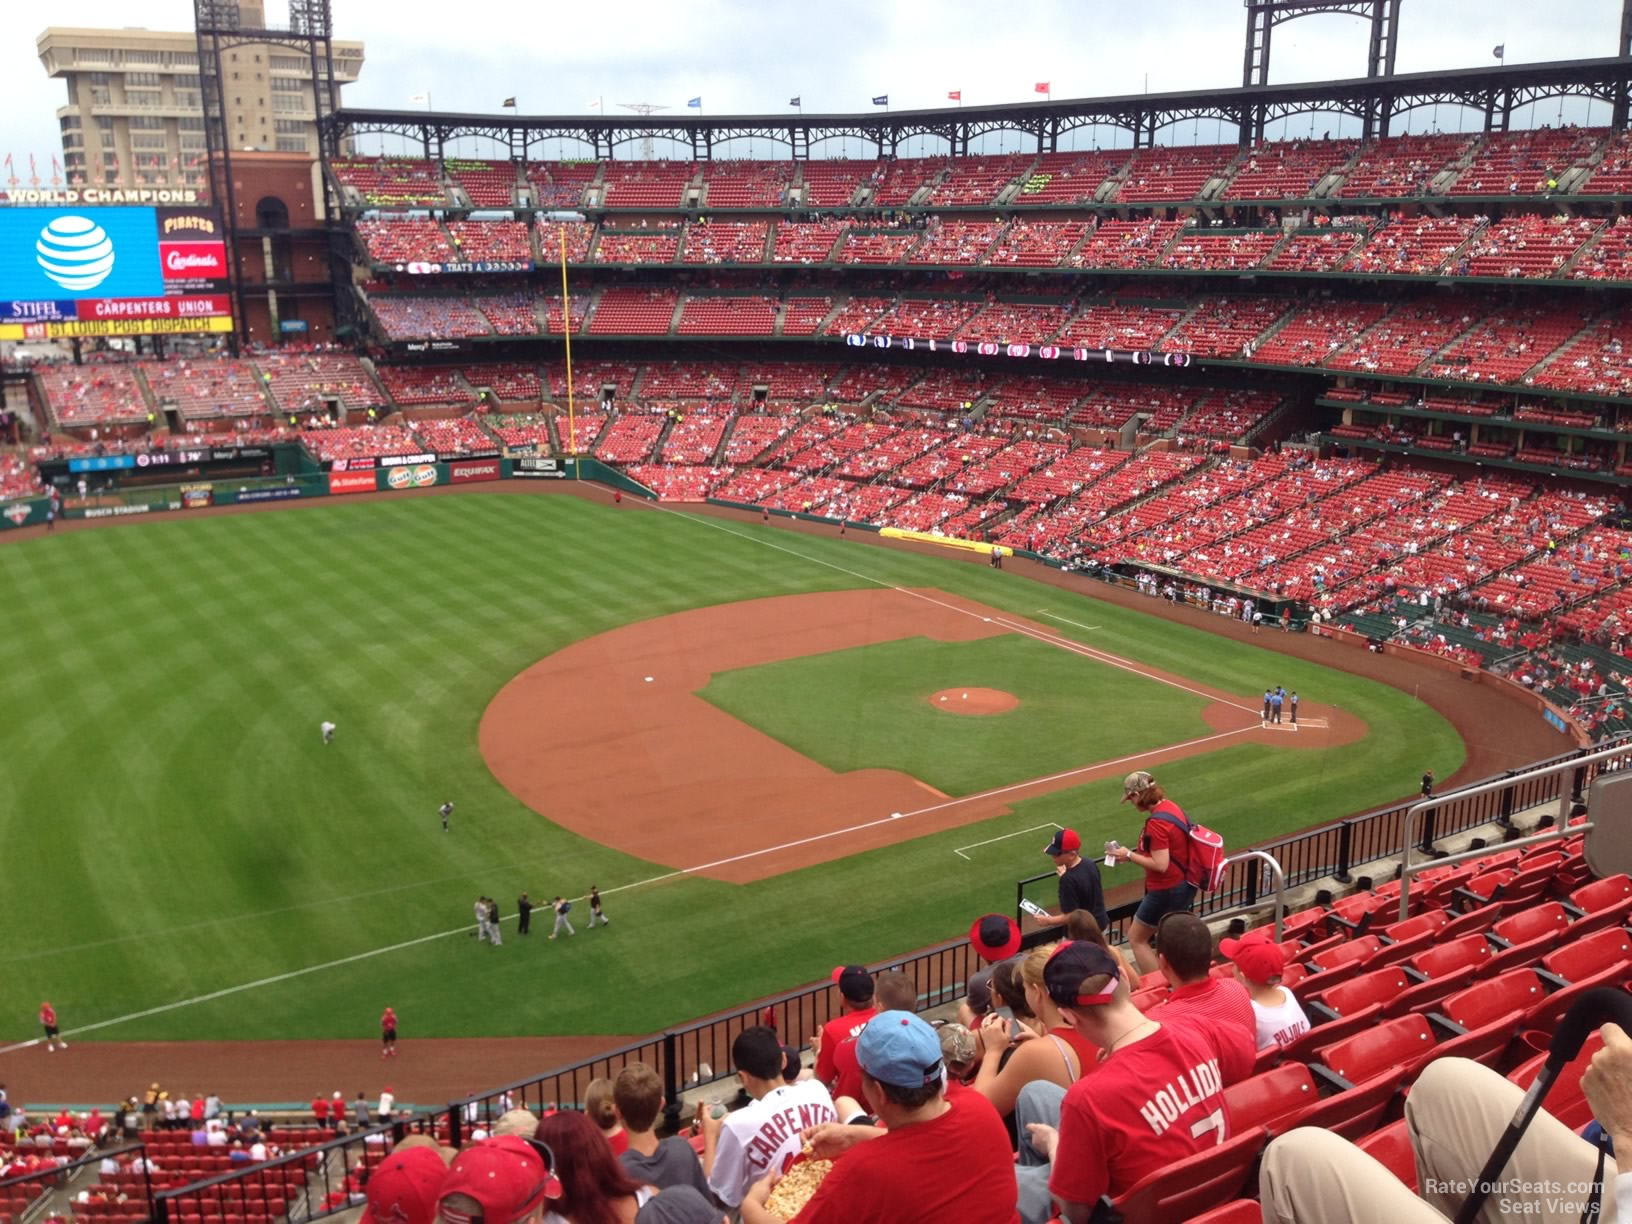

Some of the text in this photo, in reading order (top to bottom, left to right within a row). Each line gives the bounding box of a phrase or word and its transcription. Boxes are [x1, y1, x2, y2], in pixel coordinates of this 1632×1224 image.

[7, 188, 197, 203] WORLD CHAMPIONS
[164, 216, 214, 233] PIRATES
[167, 250, 218, 270] Cardinals
[96, 301, 171, 315] CARPENTERS
[178, 300, 213, 313] UNION
[71, 320, 108, 335] LOUIS
[113, 316, 211, 335] POST-DISPATCH
[390, 472, 410, 483] Gulf
[414, 470, 434, 481] Gulf
[453, 465, 496, 477] EQUIFAX
[1190, 1107, 1225, 1146] 7
